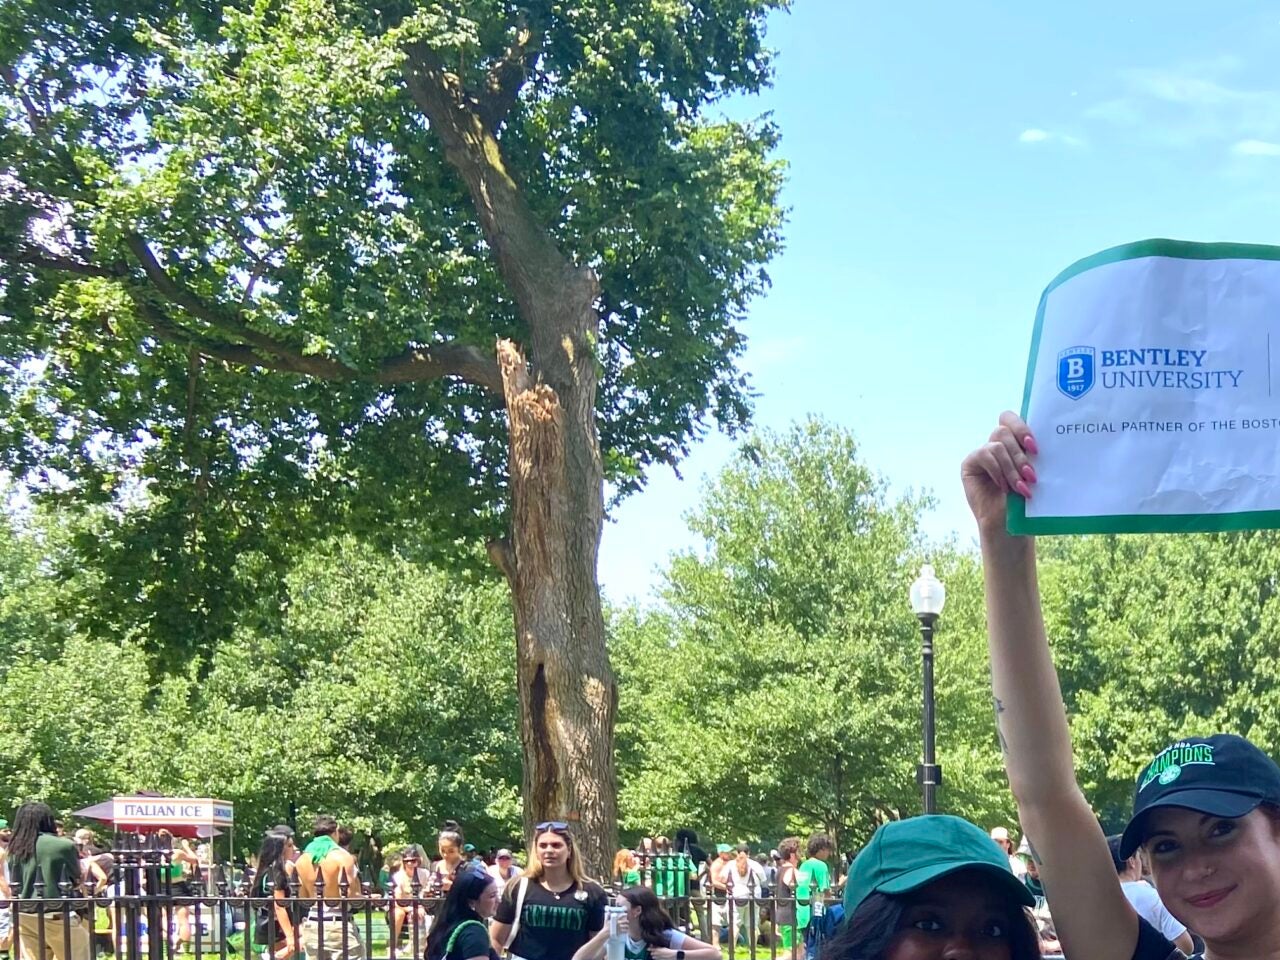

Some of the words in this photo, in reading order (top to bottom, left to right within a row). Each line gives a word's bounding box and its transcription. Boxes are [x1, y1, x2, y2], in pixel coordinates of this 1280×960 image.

[1101, 348, 1207, 367] BENTLEY
[1067, 357, 1085, 378] B
[1067, 384, 1085, 392] 1917
[1102, 370, 1244, 389] UNIVERSITY
[1056, 423, 1116, 434] OFFICIAL
[1122, 421, 1183, 432] PARTNER
[1188, 422, 1206, 432] OF
[1211, 420, 1237, 430] THE
[124, 804, 176, 817] ITALIAN
[180, 805, 203, 817] ICE
[524, 904, 587, 930] CELTICS
